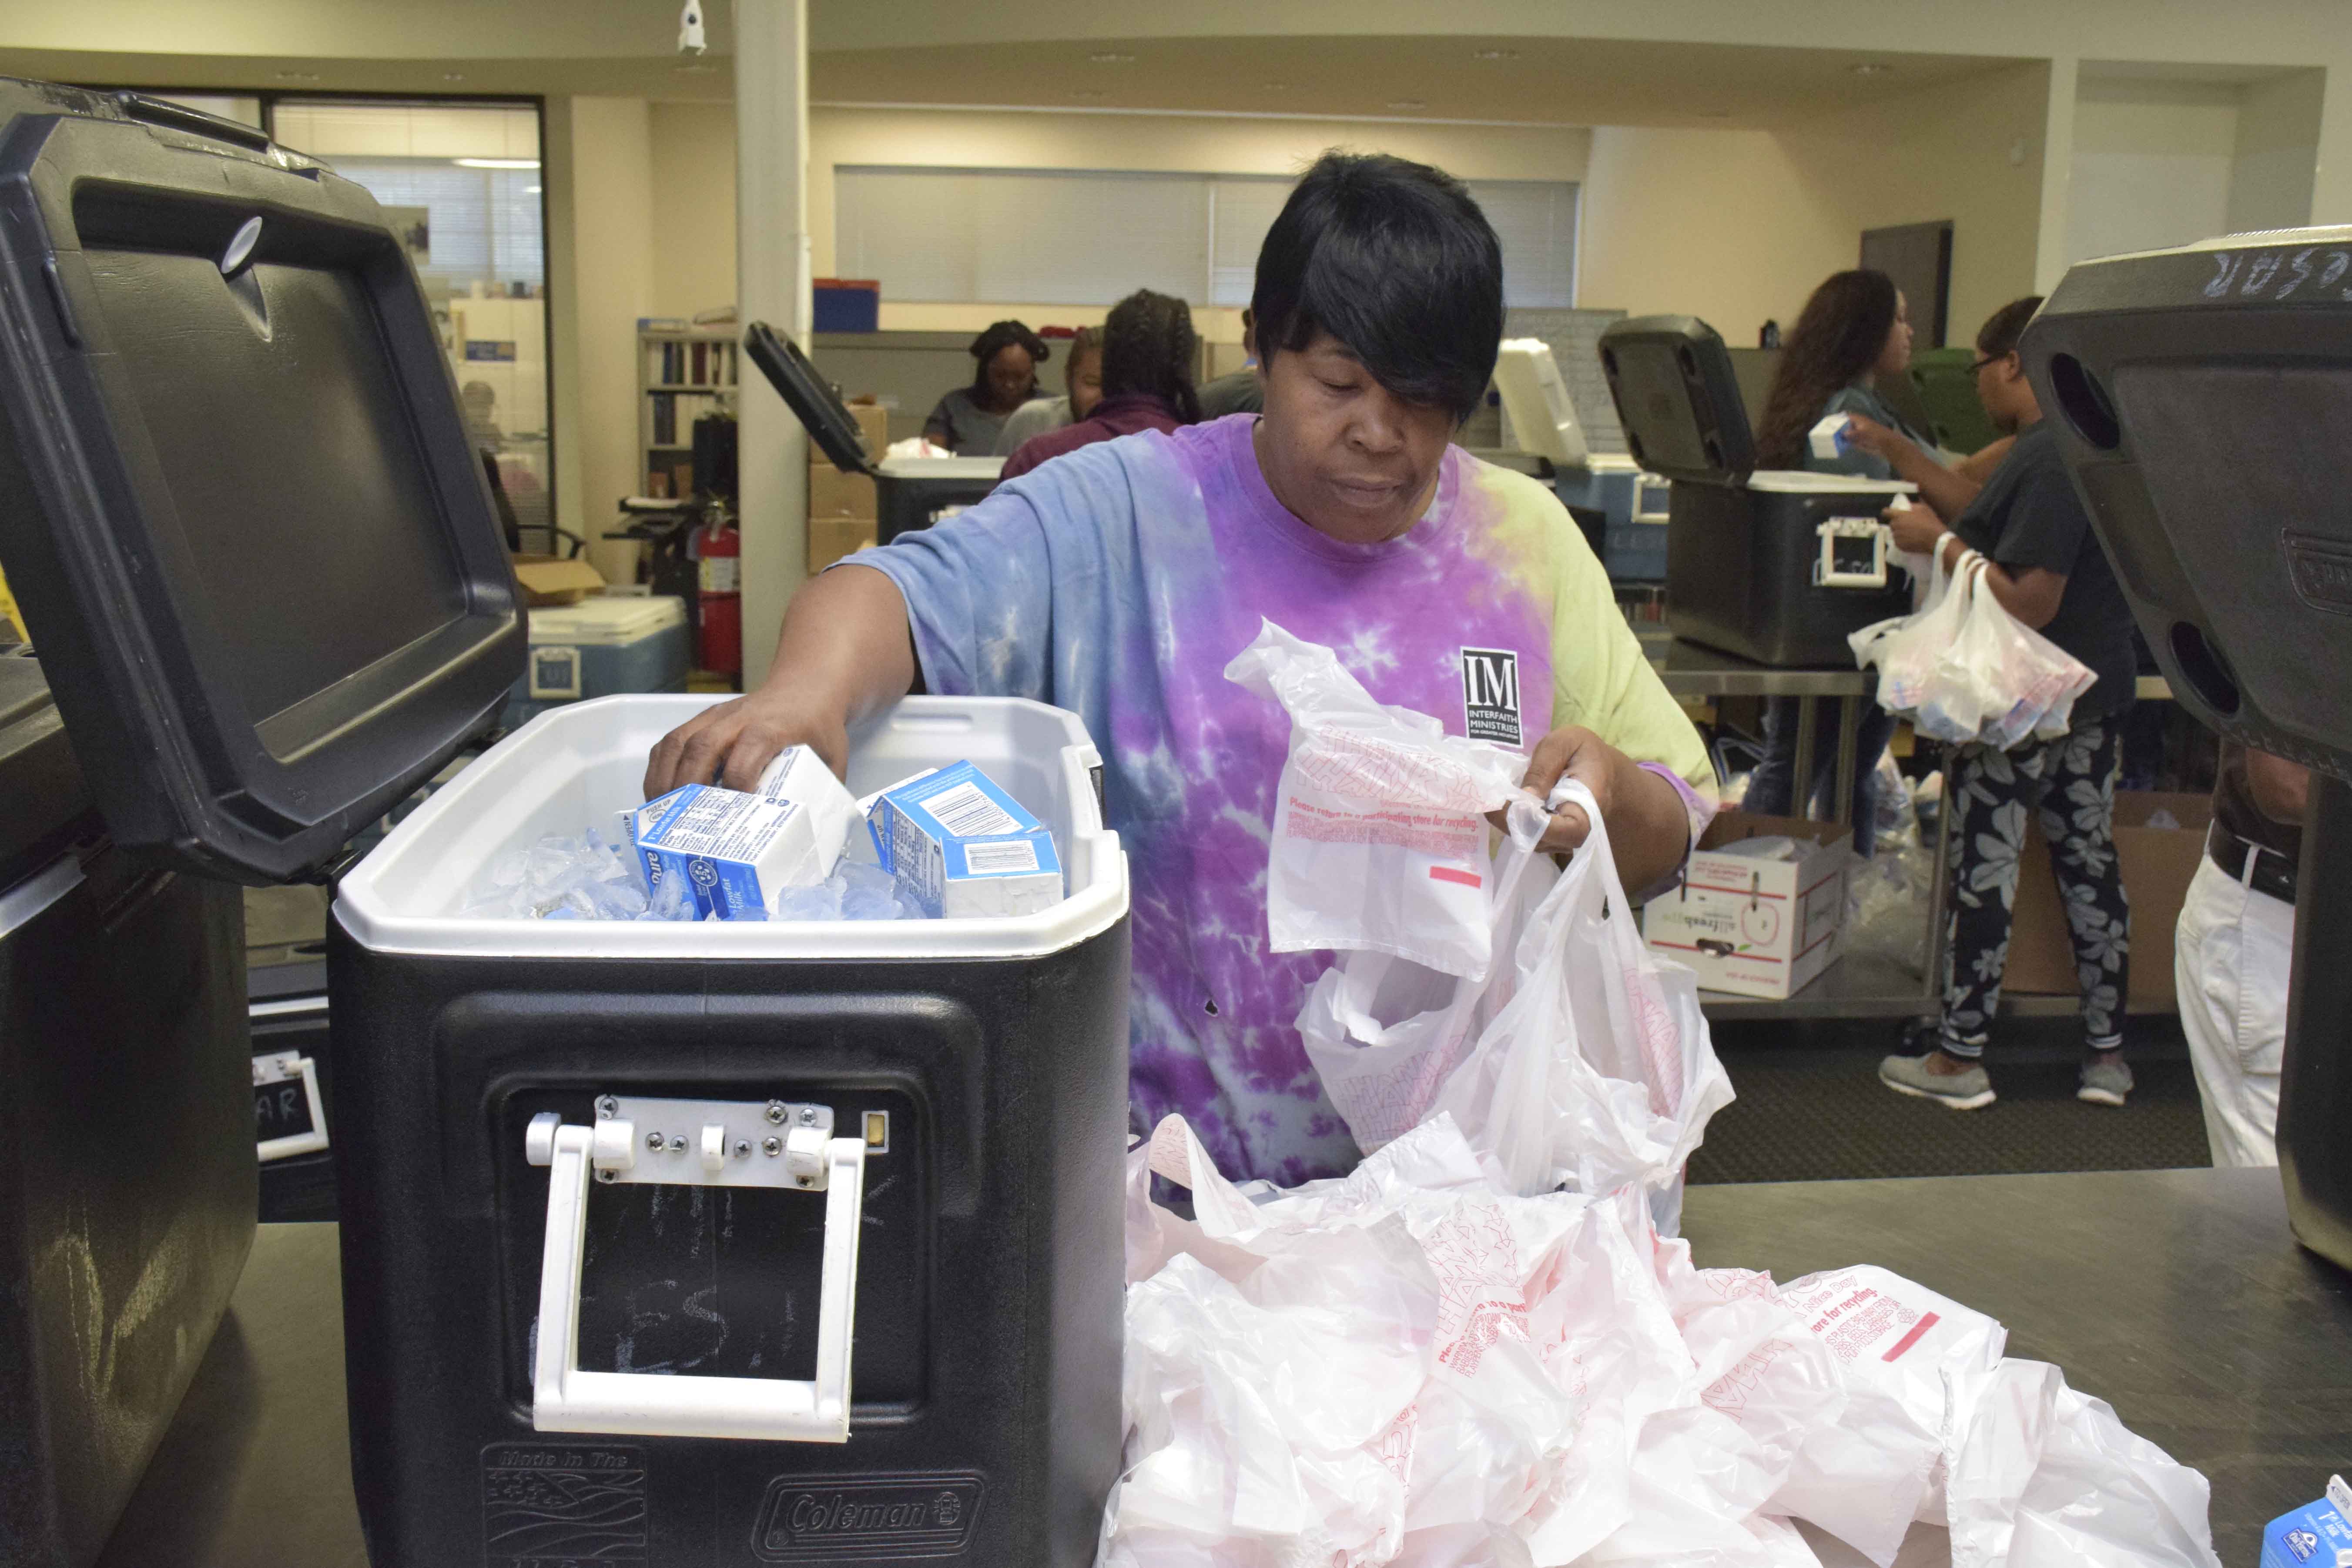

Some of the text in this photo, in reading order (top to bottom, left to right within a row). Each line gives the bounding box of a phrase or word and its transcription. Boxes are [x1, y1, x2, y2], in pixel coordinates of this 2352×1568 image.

[1464, 655, 1517, 711] IM
[1469, 710, 1518, 723] INTERFAITH
[1470, 720, 1518, 734] MINISTRIES
[646, 803, 662, 814] PUSH
[1289, 797, 1314, 813] Please
[1413, 813, 1431, 825] store
[722, 878, 737, 909] Lowfat
[1803, 1275, 1859, 1314] Nice Day
[1823, 1307, 1842, 1320] for
[1839, 1287, 1878, 1311] recycling.
[499, 1450, 628, 1468] Made In The
[786, 1494, 926, 1534] Coleman
